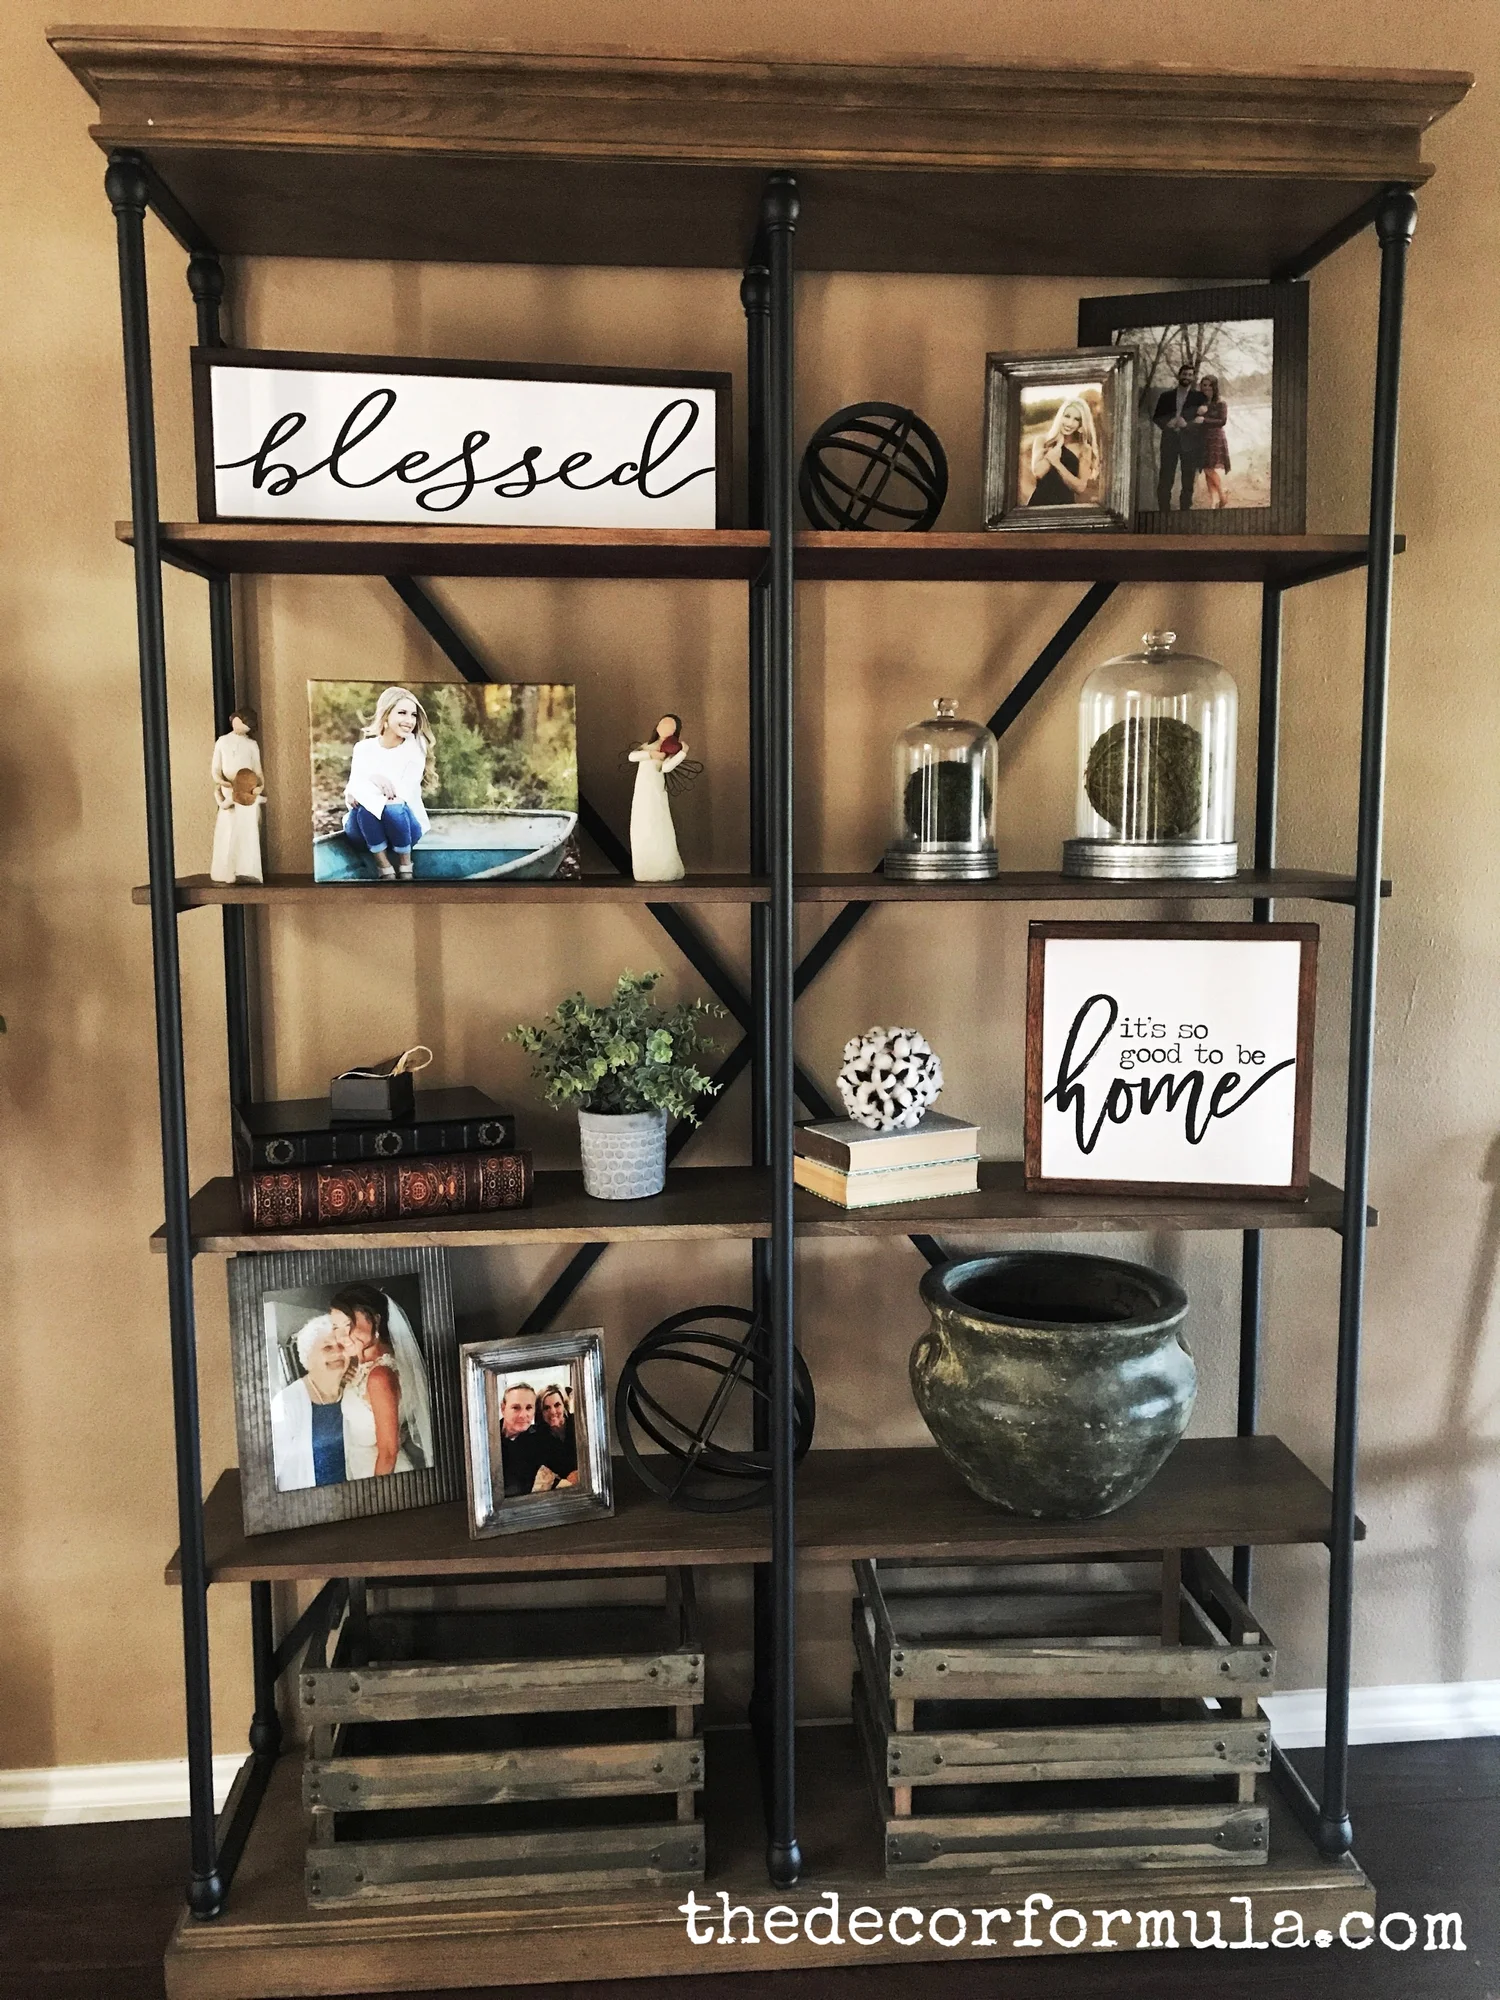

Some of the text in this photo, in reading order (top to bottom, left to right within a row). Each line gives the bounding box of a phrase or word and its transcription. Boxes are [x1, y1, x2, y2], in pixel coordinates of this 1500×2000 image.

[214, 388, 716, 512] blessed
[1119, 1016, 1209, 1040] it's so
[1119, 1043, 1266, 1070] good to be
[1044, 993, 1295, 1155] home
